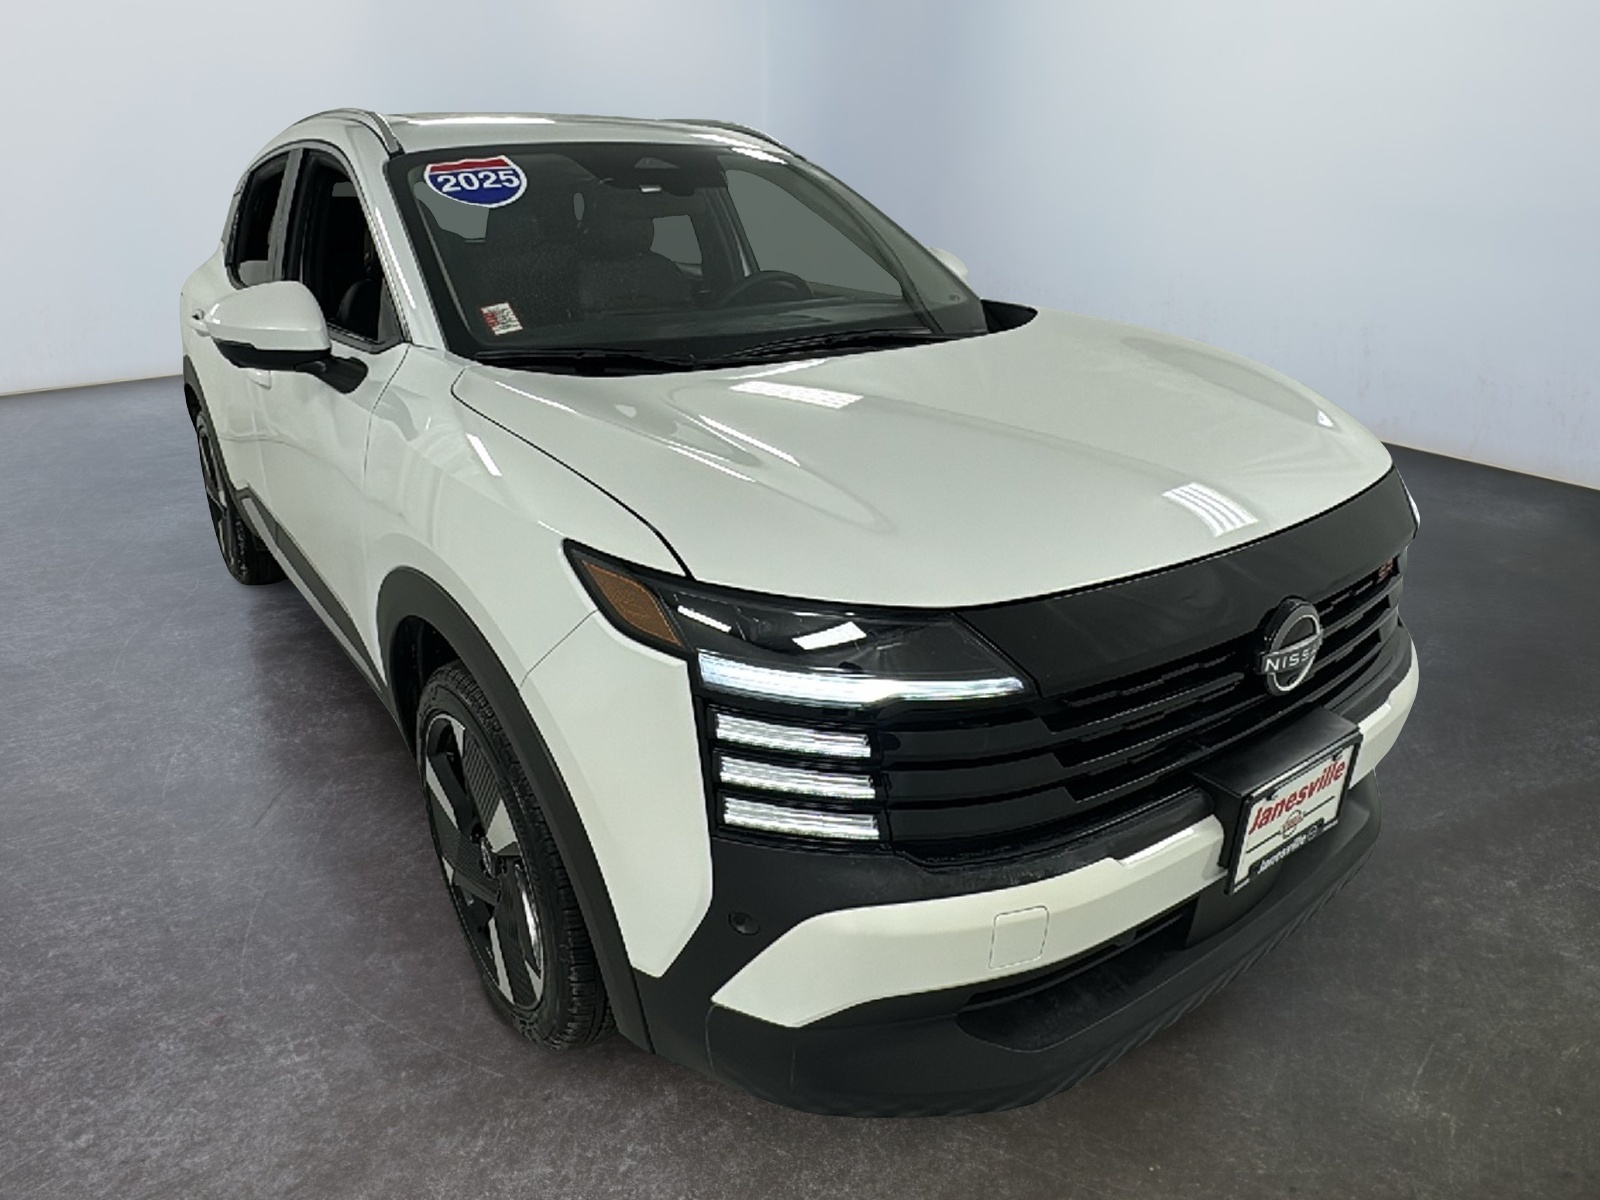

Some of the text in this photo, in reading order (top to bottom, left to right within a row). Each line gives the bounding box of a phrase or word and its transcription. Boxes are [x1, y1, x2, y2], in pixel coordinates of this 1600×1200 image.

[436, 170, 521, 192] 2025
[1264, 645, 1317, 672] NISS
[1248, 761, 1346, 836] Janesville
